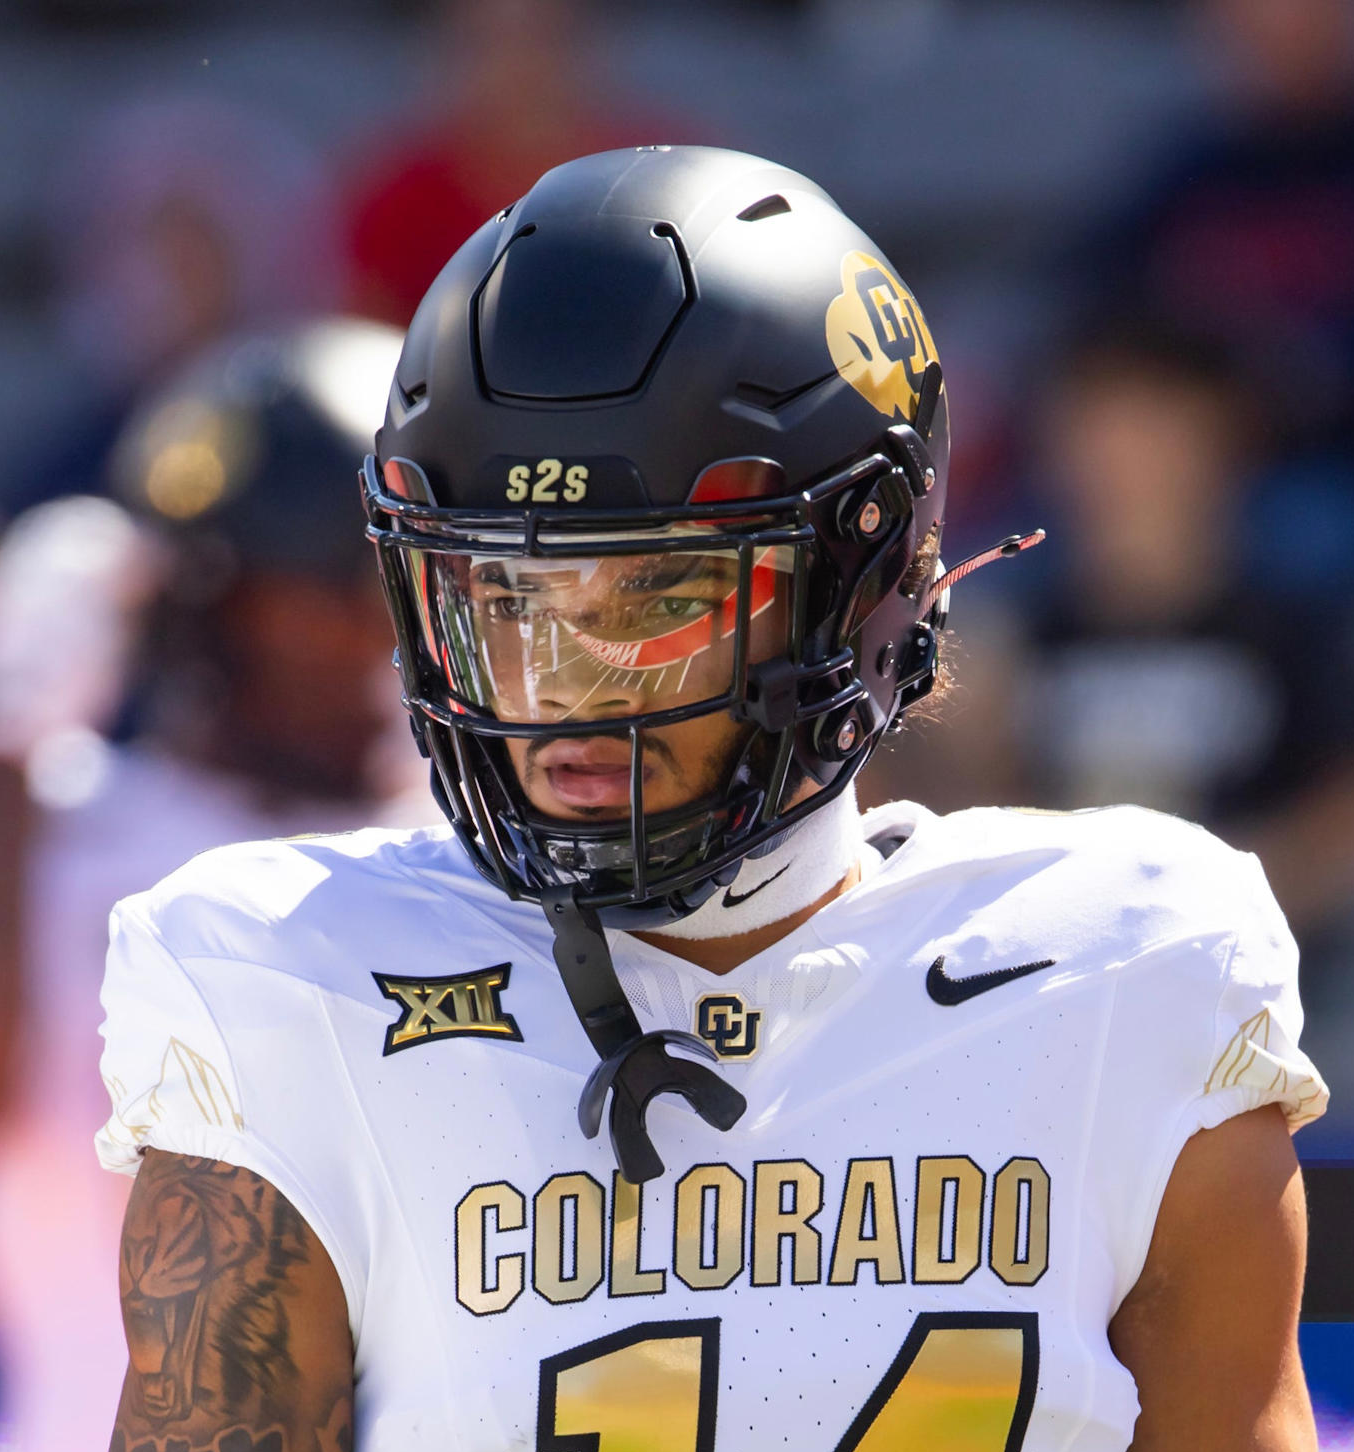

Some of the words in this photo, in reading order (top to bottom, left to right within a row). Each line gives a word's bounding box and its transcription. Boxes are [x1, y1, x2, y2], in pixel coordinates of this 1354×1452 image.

[506, 458, 589, 502] s2s
[696, 994, 761, 1058] CU
[454, 1155, 1052, 1317] COLORADO
